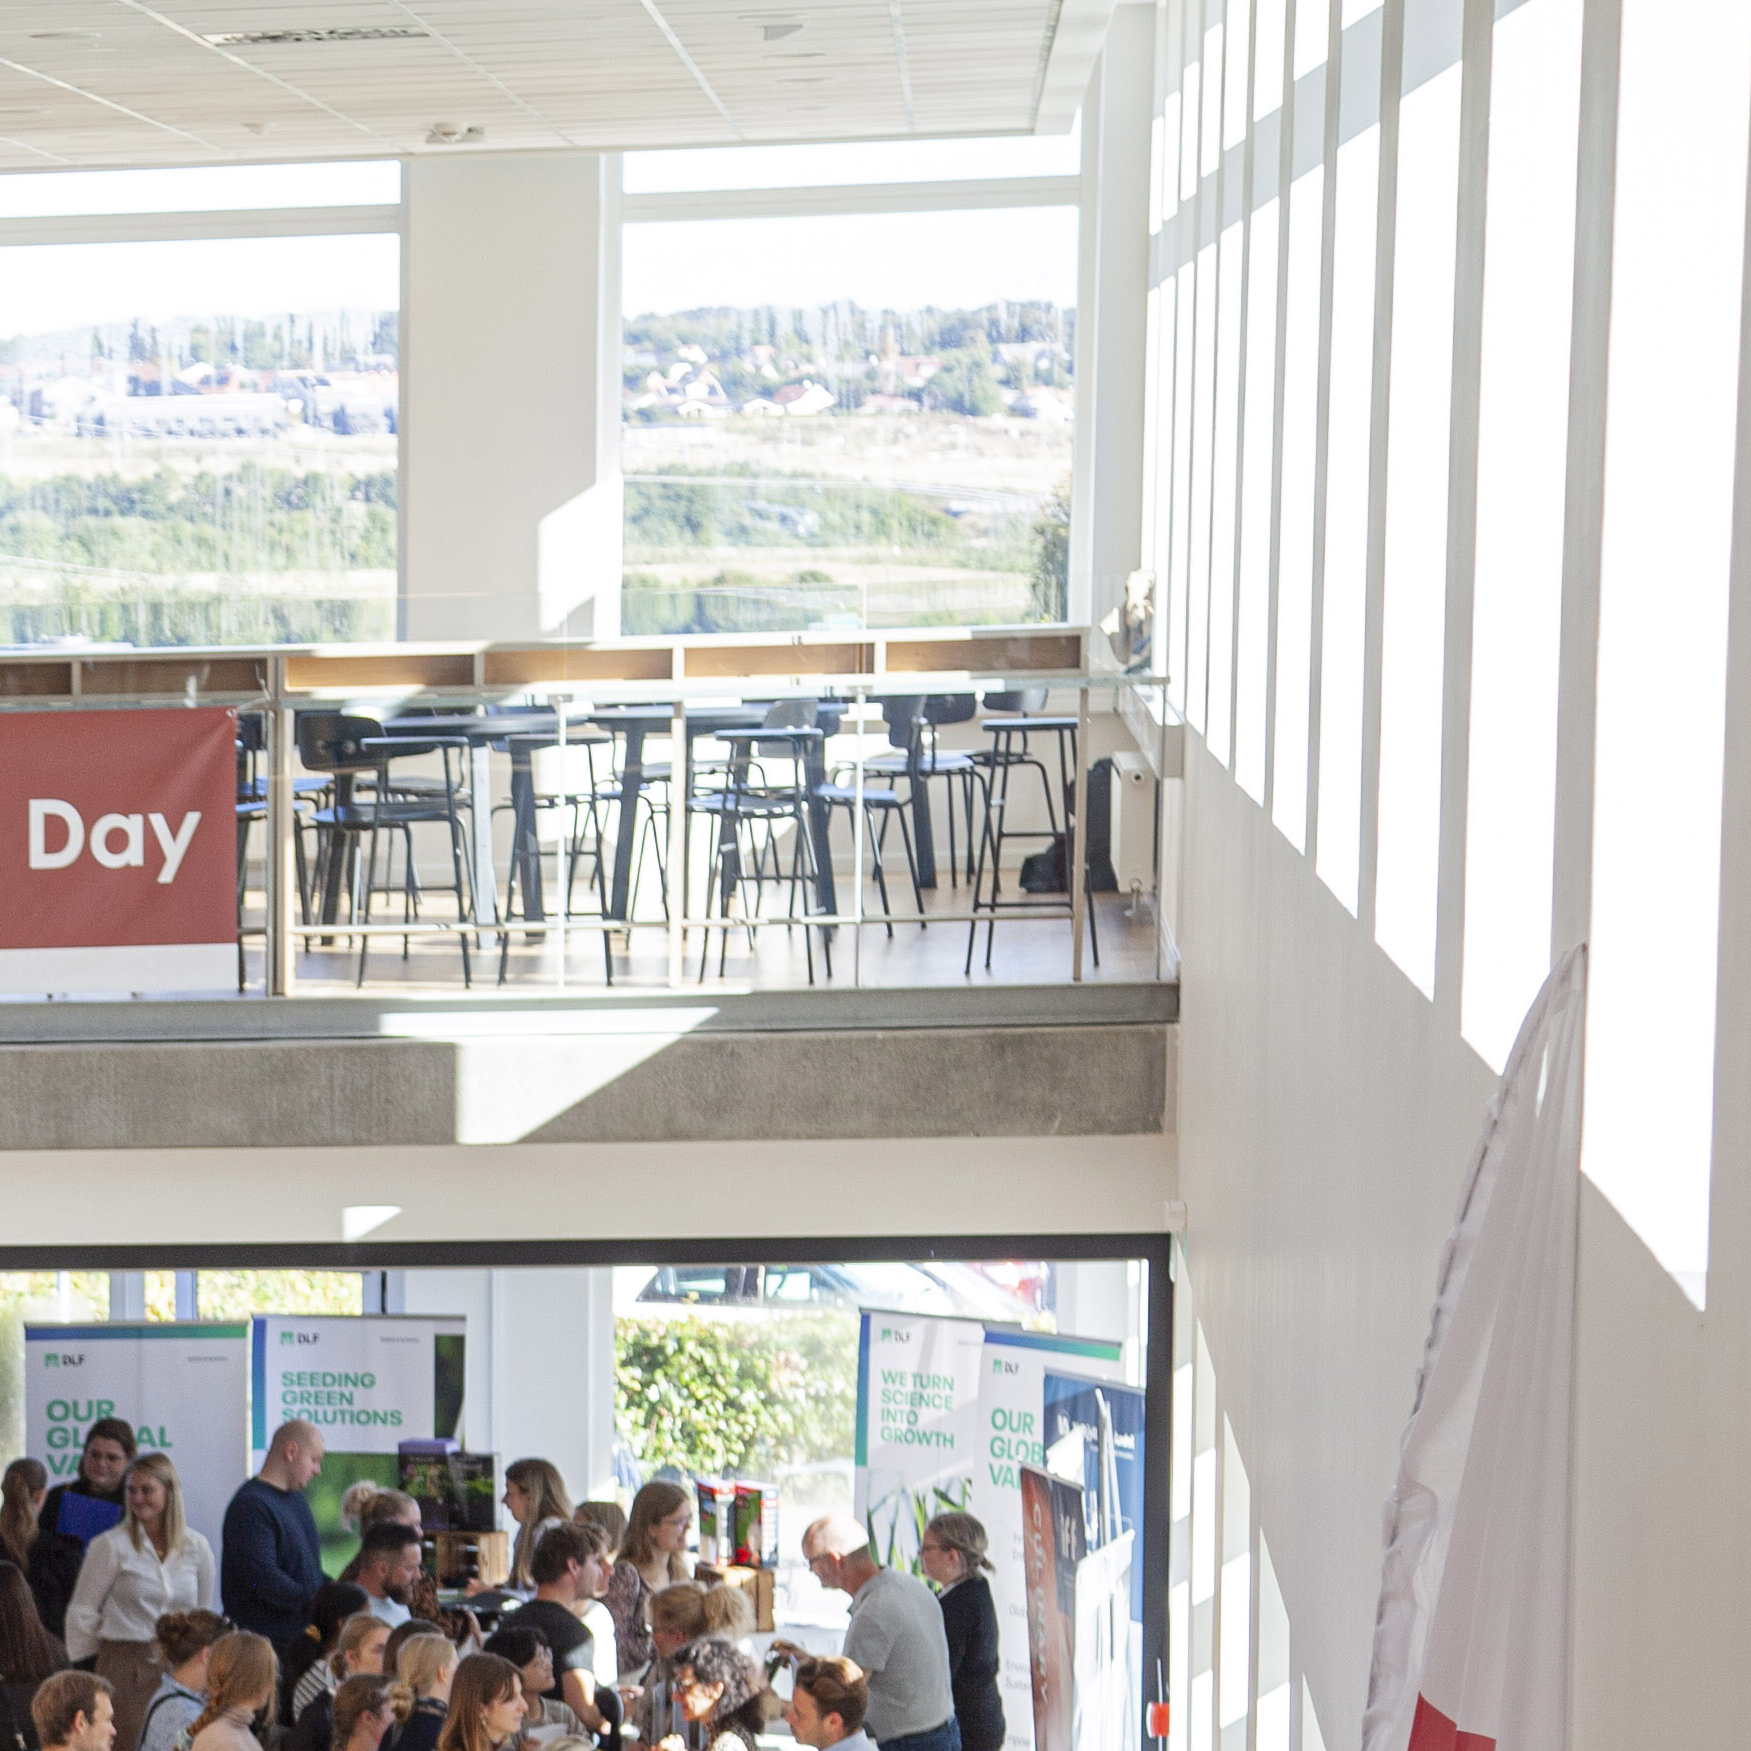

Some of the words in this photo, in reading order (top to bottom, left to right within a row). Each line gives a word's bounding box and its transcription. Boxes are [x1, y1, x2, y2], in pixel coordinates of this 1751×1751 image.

[28, 797, 202, 884] Day
[298, 1332, 320, 1345] DLF
[62, 1354, 85, 1367] DLF
[281, 1371, 376, 1389] SEEDING
[881, 1370, 906, 1387] WE
[911, 1371, 955, 1392] TURN
[281, 1389, 354, 1406] GREEN
[881, 1388, 954, 1411] SCIENCE
[46, 1399, 115, 1423] OUR
[881, 1407, 918, 1426] INTO
[990, 1407, 1034, 1435] OUR
[46, 1426, 173, 1449] GLAL
[880, 1426, 955, 1448] GROWTH
[989, 1436, 1044, 1465] GLOB
